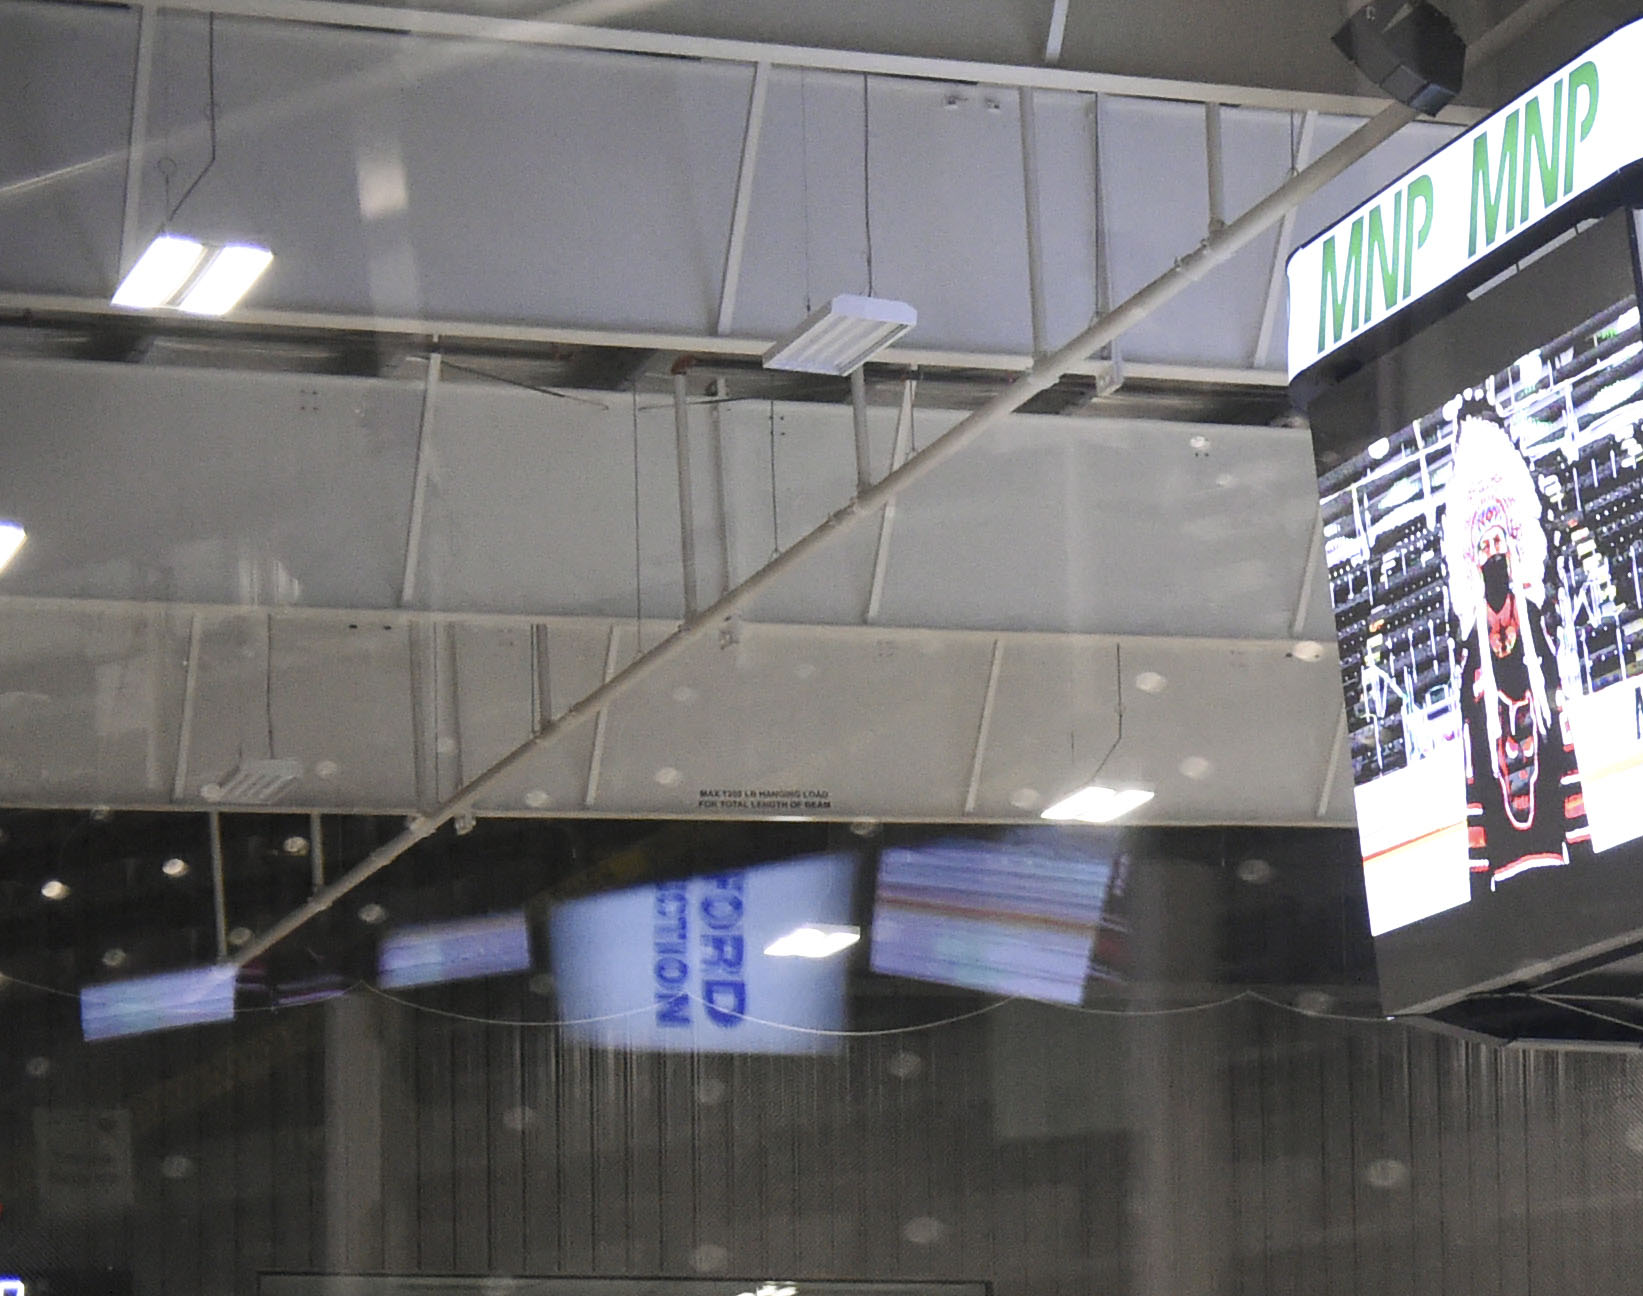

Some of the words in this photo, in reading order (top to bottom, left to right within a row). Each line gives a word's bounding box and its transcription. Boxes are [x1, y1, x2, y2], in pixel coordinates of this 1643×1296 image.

[1468, 60, 1600, 259] MNP
[1317, 174, 1434, 354] MNP
[720, 800, 749, 808] TOTAL
[750, 800, 788, 808] LENGTH
[802, 790, 829, 799] LOAD
